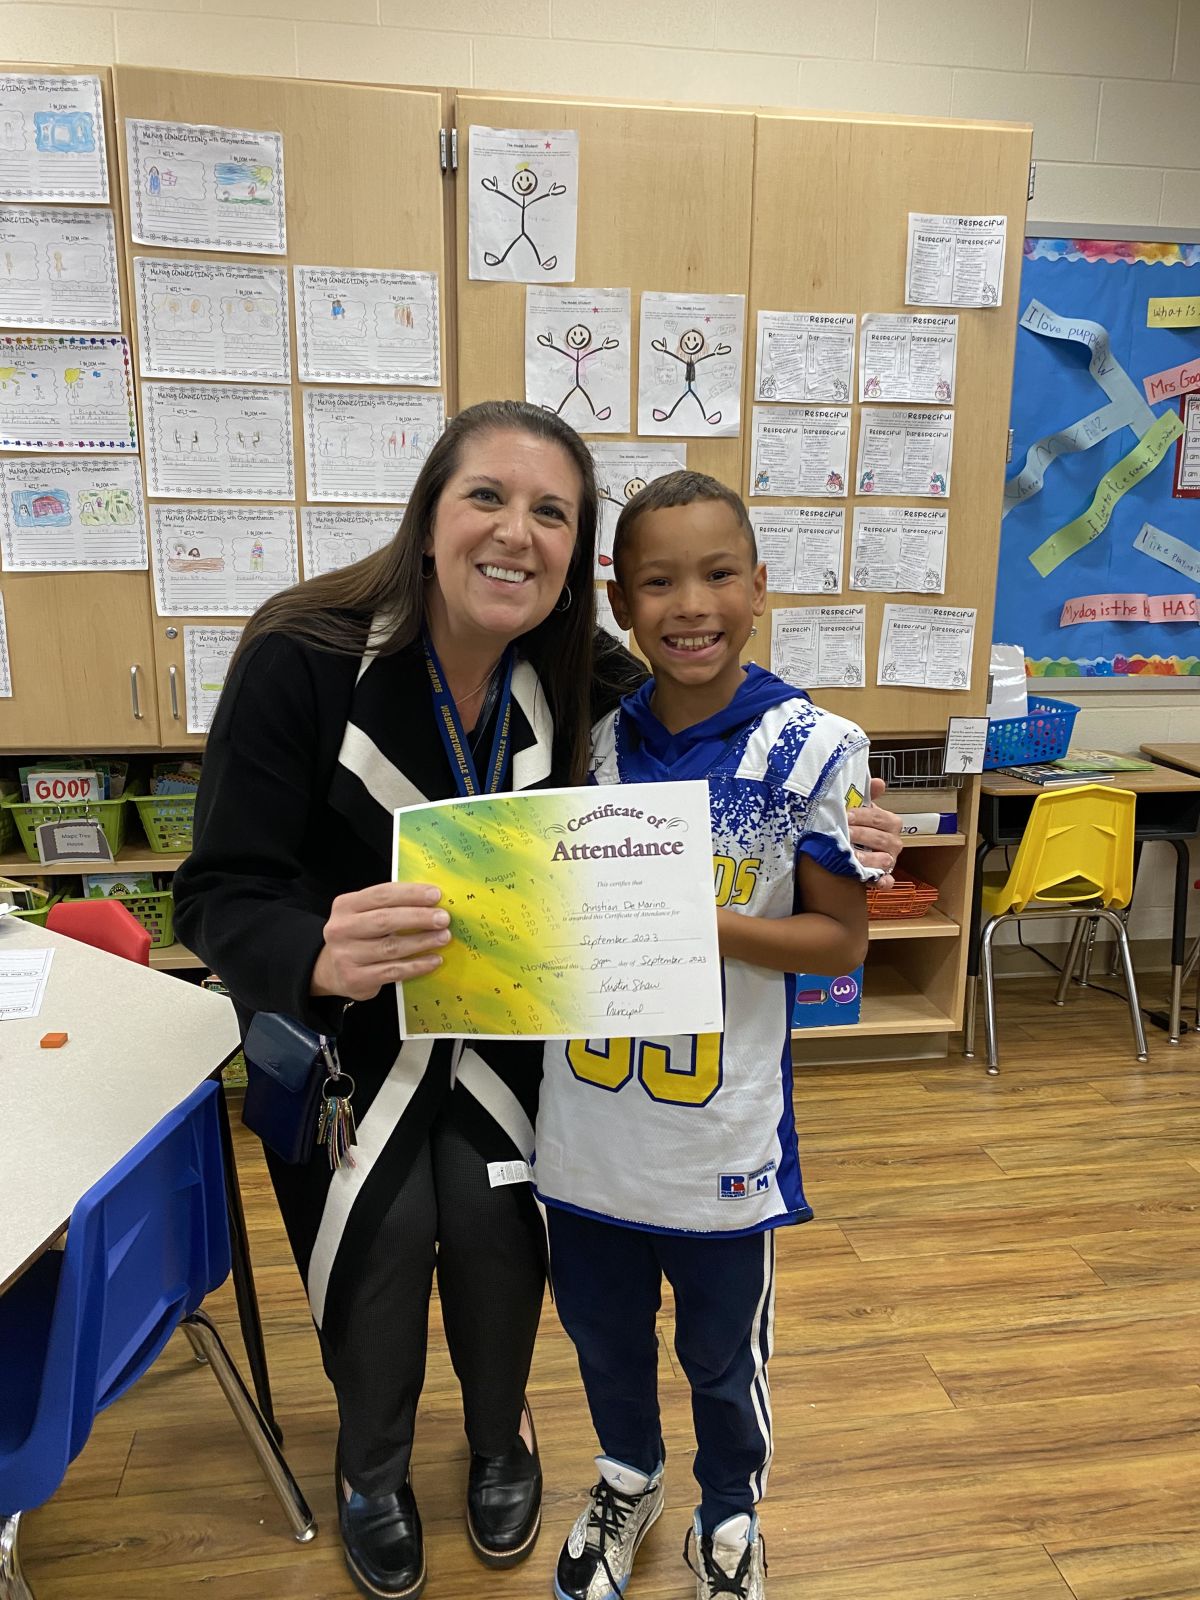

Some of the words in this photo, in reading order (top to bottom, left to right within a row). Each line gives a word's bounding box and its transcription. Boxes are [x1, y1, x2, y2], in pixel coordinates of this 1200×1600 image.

[959, 218, 1005, 227] Respectful
[809, 315, 854, 324] Respectful
[912, 316, 956, 325] Respectful
[1026, 306, 1038, 324] I
[1037, 313, 1061, 333] love
[804, 409, 849, 418] Respectful
[907, 412, 952, 421] Respectful
[799, 509, 843, 518] Respectful
[933, 608, 975, 618] Respectful
[35, 778, 91, 800] GOOD
[567, 803, 644, 832] Certificate
[647, 814, 668, 829] of
[550, 836, 685, 862] Attendance
[580, 934, 628, 949] September
[639, 955, 686, 967] September
[757, 1175, 769, 1191] M
